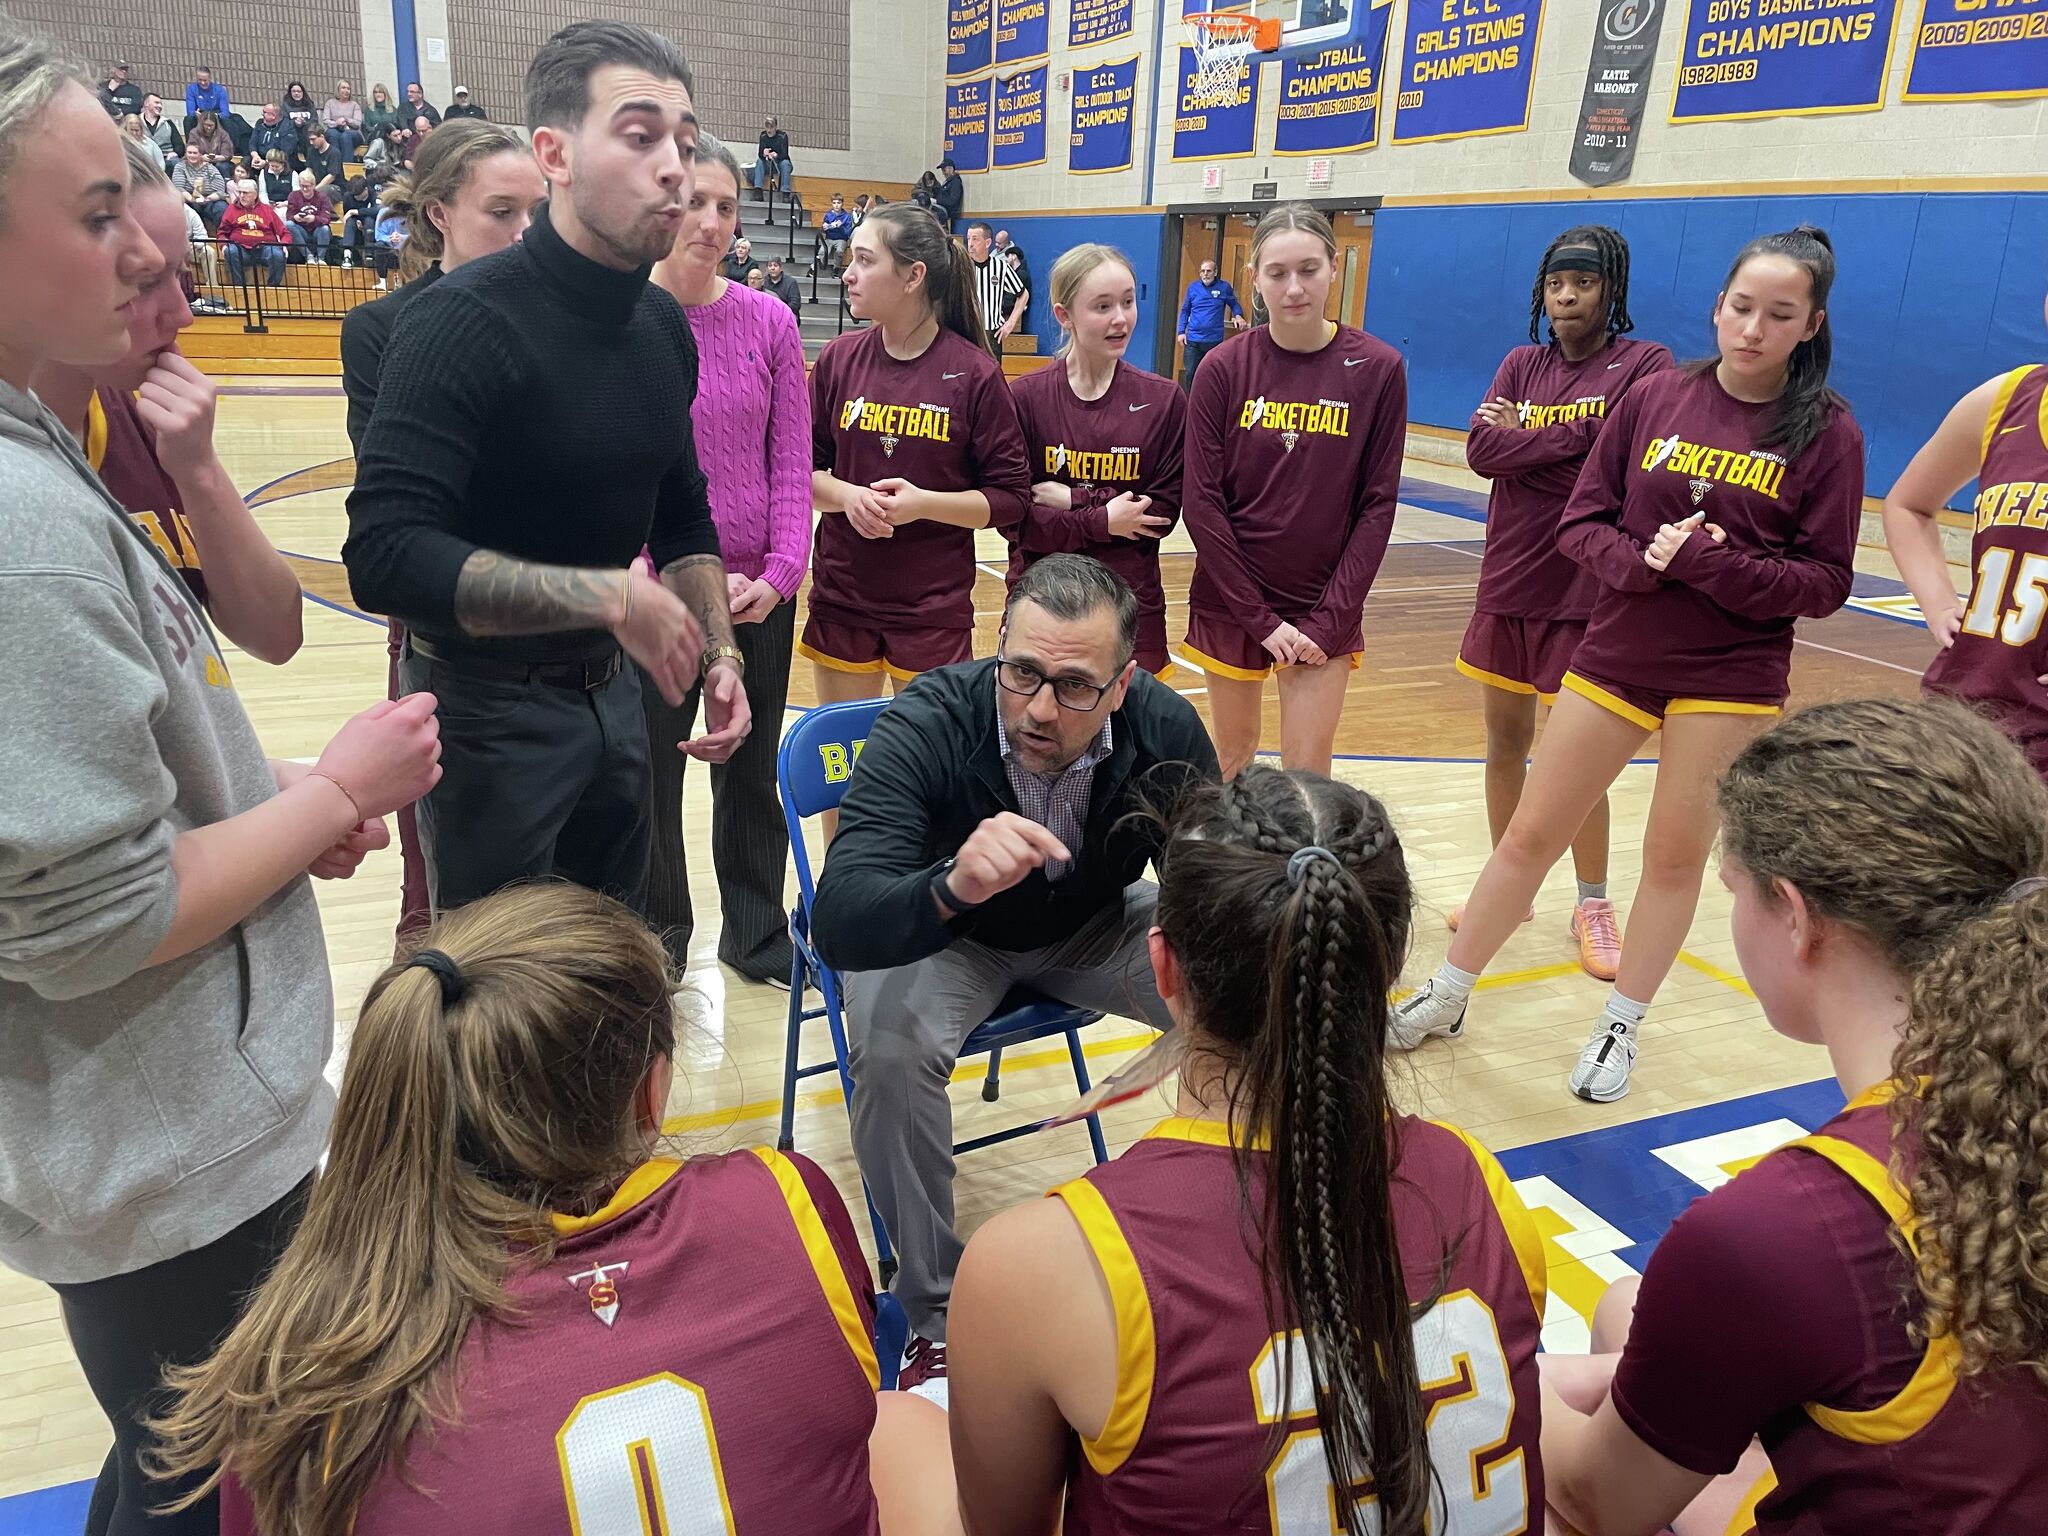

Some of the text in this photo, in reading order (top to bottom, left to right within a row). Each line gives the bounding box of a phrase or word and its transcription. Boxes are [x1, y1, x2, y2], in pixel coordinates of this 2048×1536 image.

[1002, 2, 1045, 26] CHAMPIONS
[1708, 0, 1750, 22] BOYS
[950, 16, 989, 40] CHAMPIONS
[1416, 13, 1525, 54] GIRLS TENNIS
[1697, 12, 1875, 58] CHAMPIONS
[1924, 24, 1968, 45] 2008
[1976, 18, 2024, 40] 2009
[1298, 45, 1366, 72] OTBALL
[1413, 45, 1519, 84] CHAMPIONS
[1288, 68, 1372, 98] CHAMPIONS
[1602, 70, 1630, 80] KATIE
[1682, 62, 1754, 85] 1982 1983
[1075, 86, 1132, 108] GIRLS OUTDOOR TRACK
[1594, 82, 1638, 94] MAHONEY
[962, 102, 987, 118] LACROSSE
[1013, 90, 1042, 110] LACROSSE
[1299, 105, 1316, 118] 2004
[1318, 102, 1336, 114] 2015
[1338, 98, 1357, 112] 2016
[1400, 92, 1421, 108] 2010
[949, 120, 984, 136] CHAMPIONS
[998, 109, 1042, 130] CHAMPIONS
[1076, 106, 1128, 128] CHAMPIONS
[1584, 134, 1606, 148] 2010
[1616, 136, 1626, 148] 11
[919, 402, 950, 414] SHEEHAN
[1318, 398, 1350, 409] SHEEHAN
[1110, 446, 1140, 454] SHEEHAN
[1750, 450, 1787, 466] SHEEHAN
[1974, 482, 2048, 534] HEE
[1961, 546, 2048, 647] 15
